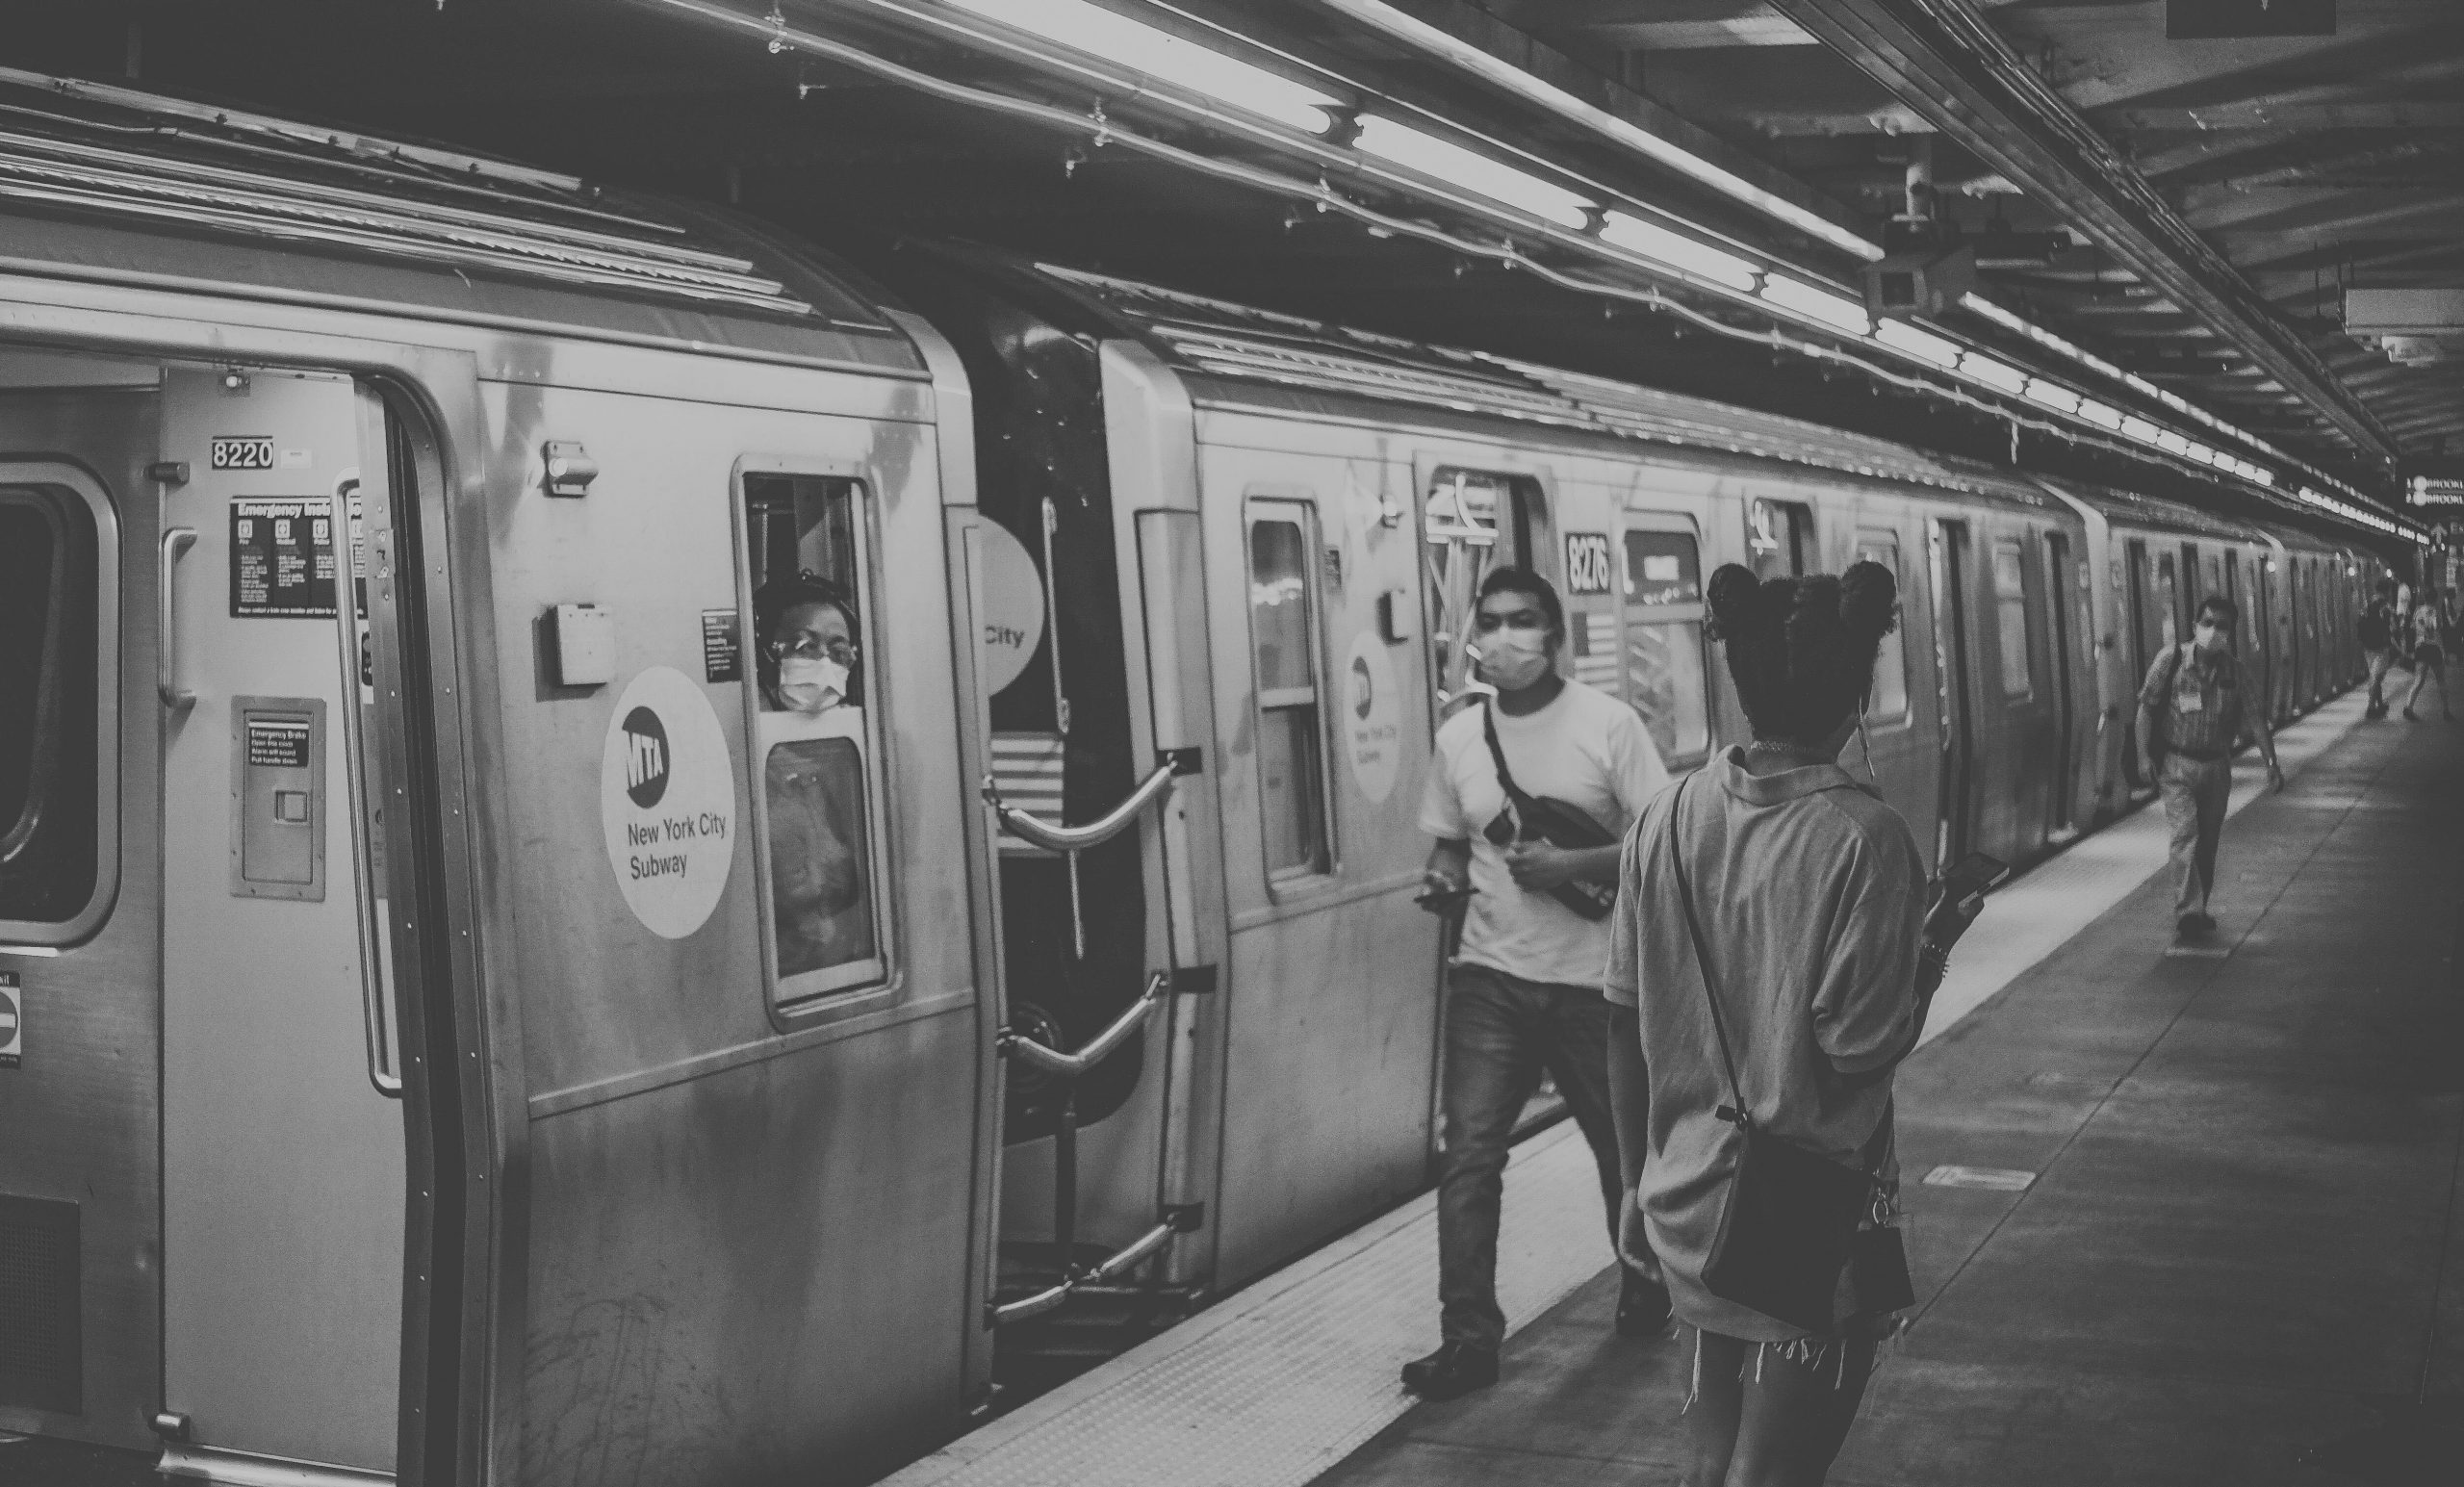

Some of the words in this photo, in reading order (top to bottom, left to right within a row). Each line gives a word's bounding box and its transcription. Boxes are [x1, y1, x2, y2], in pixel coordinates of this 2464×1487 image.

[214, 442, 273, 467] 8220
[238, 502, 302, 519] Emergency
[1568, 535, 1610, 591] 8276
[985, 626, 1025, 649] City
[625, 729, 664, 790] MTA
[628, 823, 660, 847] New
[663, 815, 696, 842] York
[699, 812, 727, 839] City
[629, 854, 688, 881] Subway
